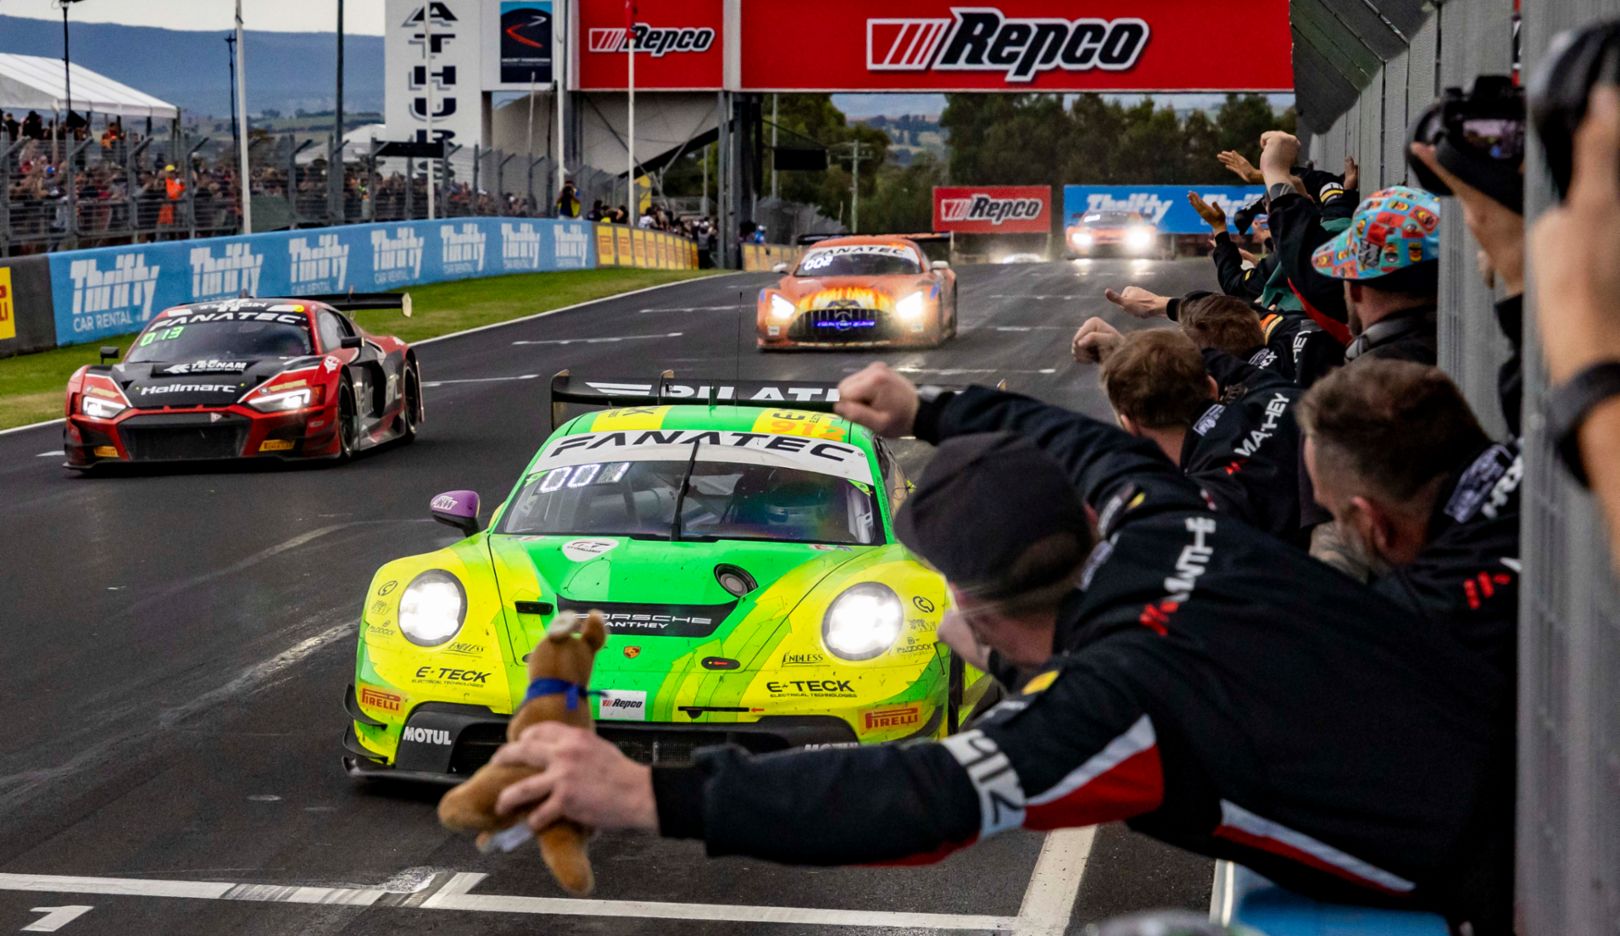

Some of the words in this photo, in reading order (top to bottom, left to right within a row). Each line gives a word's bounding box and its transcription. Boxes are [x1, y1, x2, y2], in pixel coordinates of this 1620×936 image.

[618, 23, 715, 57] Repco
[932, 7, 1149, 81] Repco
[966, 194, 1043, 224] Repco
[371, 227, 424, 279] Thrifty
[440, 223, 486, 271] Thrifty
[501, 223, 540, 268] Thrifty
[190, 243, 263, 298] Thrifty
[289, 233, 349, 290] Thrifty
[70, 253, 160, 321] Thrifty
[73, 317, 94, 332] CAR
[96, 311, 133, 329] RENTAL
[149, 312, 301, 332] FANATEC
[141, 384, 236, 395] Hallmarc
[771, 420, 846, 441] 912
[550, 430, 855, 461] FANATEC
[604, 621, 669, 629] ANTHEY
[782, 652, 824, 666] ENDLESS
[362, 688, 402, 711] PIRELLI
[612, 698, 643, 709] Repco
[865, 707, 918, 729] PIRELLI
[403, 726, 452, 745] MOTUL
[20, 905, 95, 932] 1
